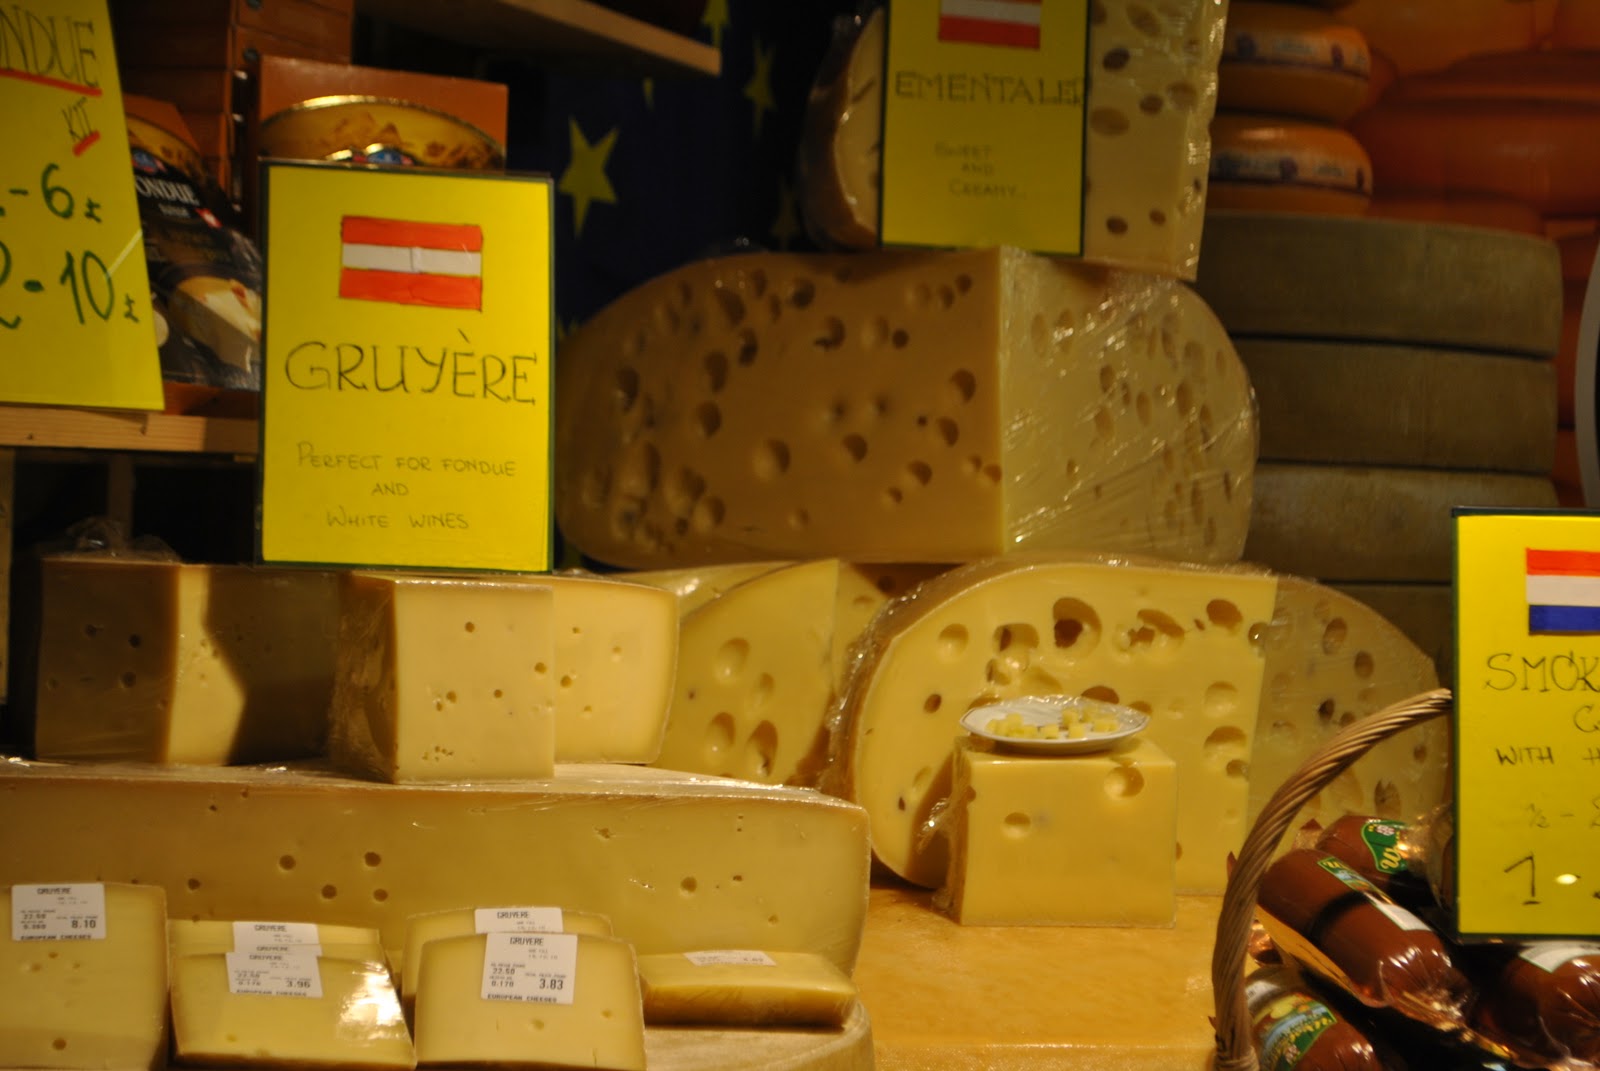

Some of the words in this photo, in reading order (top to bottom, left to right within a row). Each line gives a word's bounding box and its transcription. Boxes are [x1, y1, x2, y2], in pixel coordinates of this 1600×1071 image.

[283, 329, 537, 406] GRUYÈRE
[297, 441, 383, 471] PERFECT
[394, 456, 432, 472] FOR
[441, 458, 518, 477] FONDUE
[371, 481, 409, 497] AND
[325, 504, 391, 529] WHITE
[408, 512, 470, 530] WINES
[1572, 704, 1600, 734] C
[1495, 743, 1556, 766] WITH
[71, 919, 97, 929] 8.10
[509, 936, 544, 945] GRUYERE
[539, 978, 564, 990] 3.83
